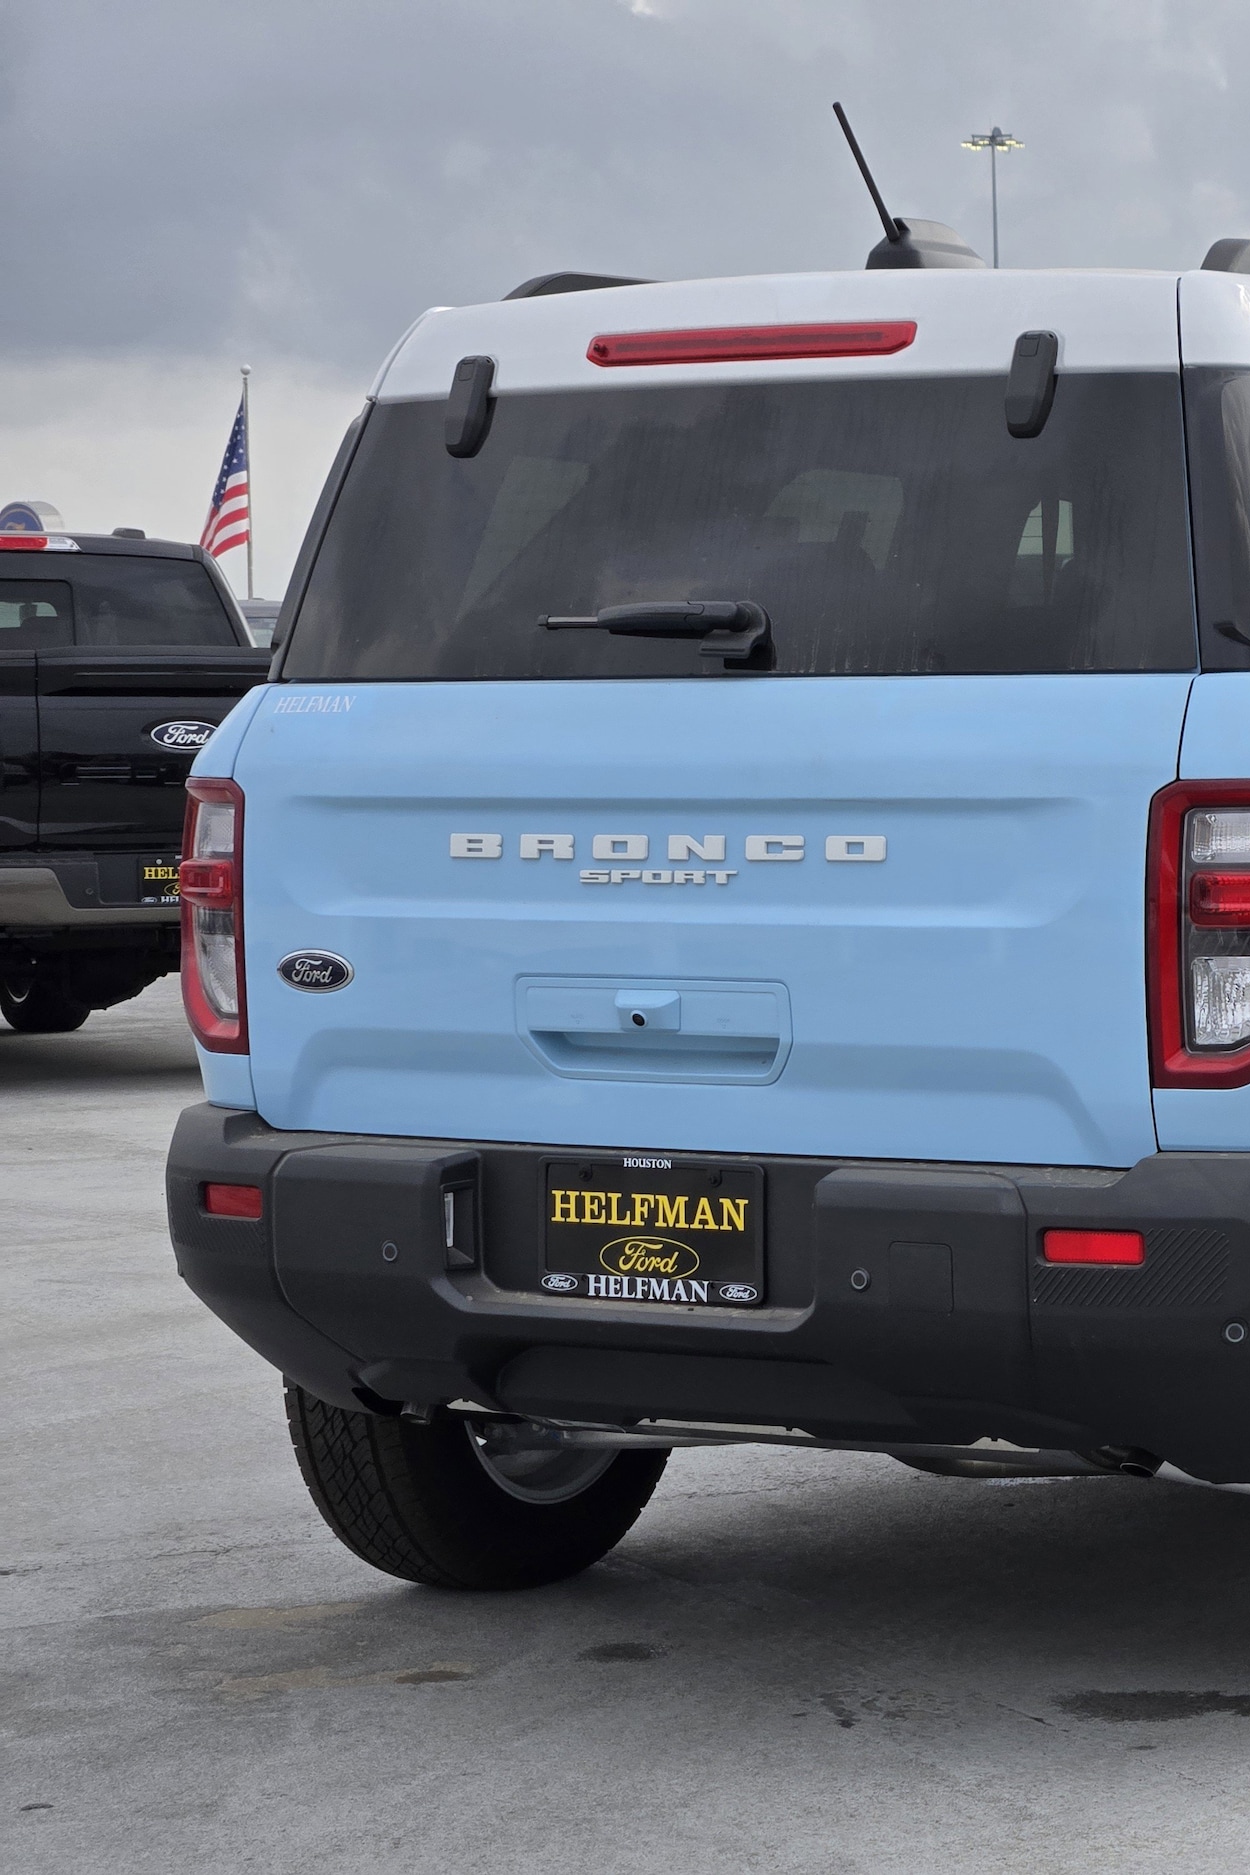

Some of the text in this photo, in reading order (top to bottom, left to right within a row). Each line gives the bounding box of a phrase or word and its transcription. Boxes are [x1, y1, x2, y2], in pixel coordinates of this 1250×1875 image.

[273, 695, 357, 714] HELFMAN
[163, 724, 210, 744] Ford
[450, 833, 888, 861] BRONCO
[579, 869, 738, 884] SPORT
[291, 958, 333, 983] Ford
[623, 1157, 672, 1170] HOUSTON
[551, 1189, 748, 1231] HELFMAN
[618, 1240, 679, 1274] Ford
[547, 1274, 750, 1302] Ford HELFMAN Ford
